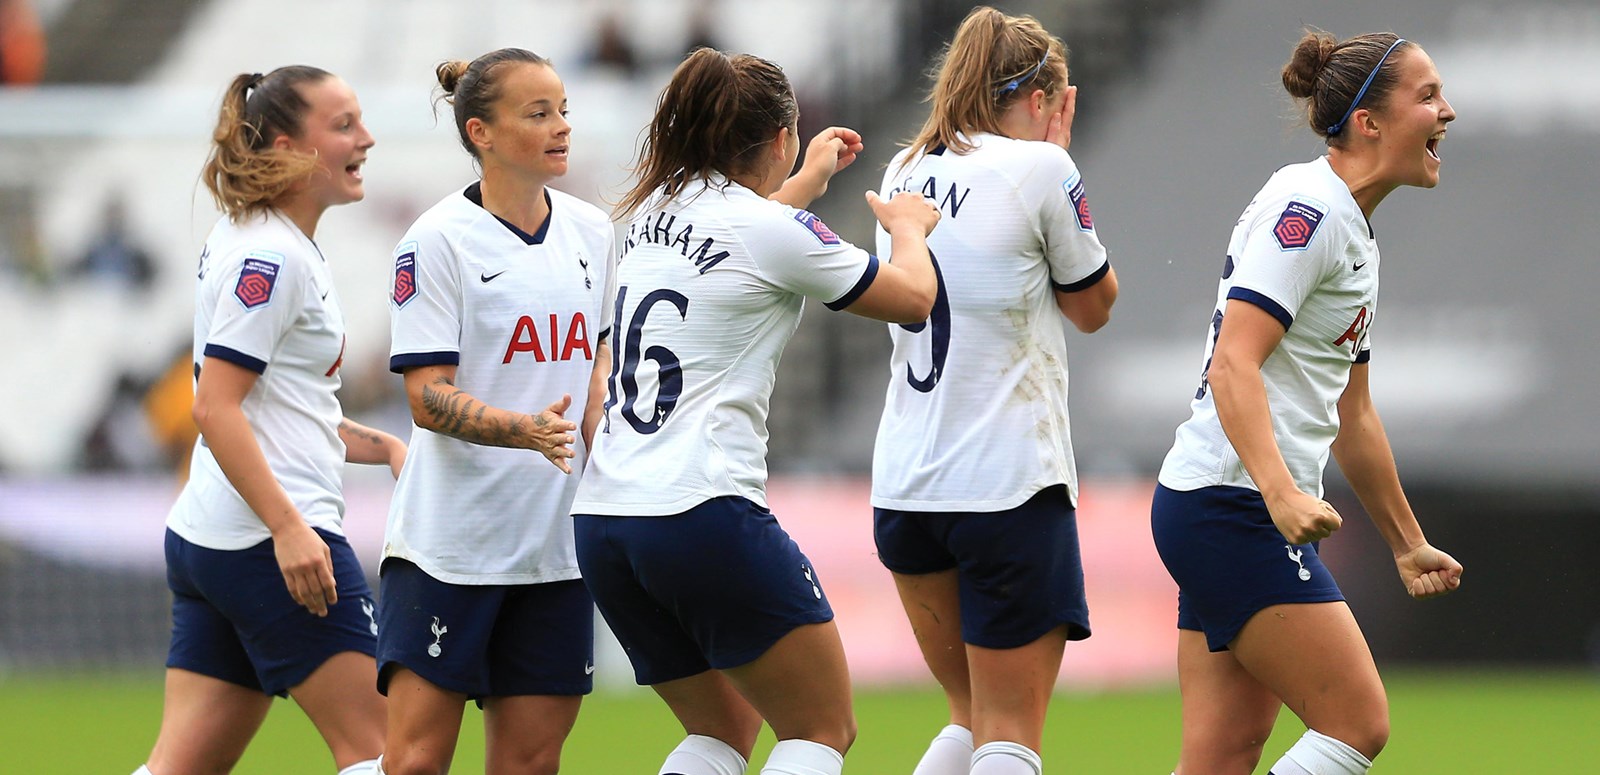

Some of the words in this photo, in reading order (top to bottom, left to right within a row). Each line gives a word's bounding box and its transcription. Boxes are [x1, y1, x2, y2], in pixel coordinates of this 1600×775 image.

[617, 210, 731, 275] RAHAM
[502, 311, 593, 365] AIA
[603, 285, 690, 435] 16
